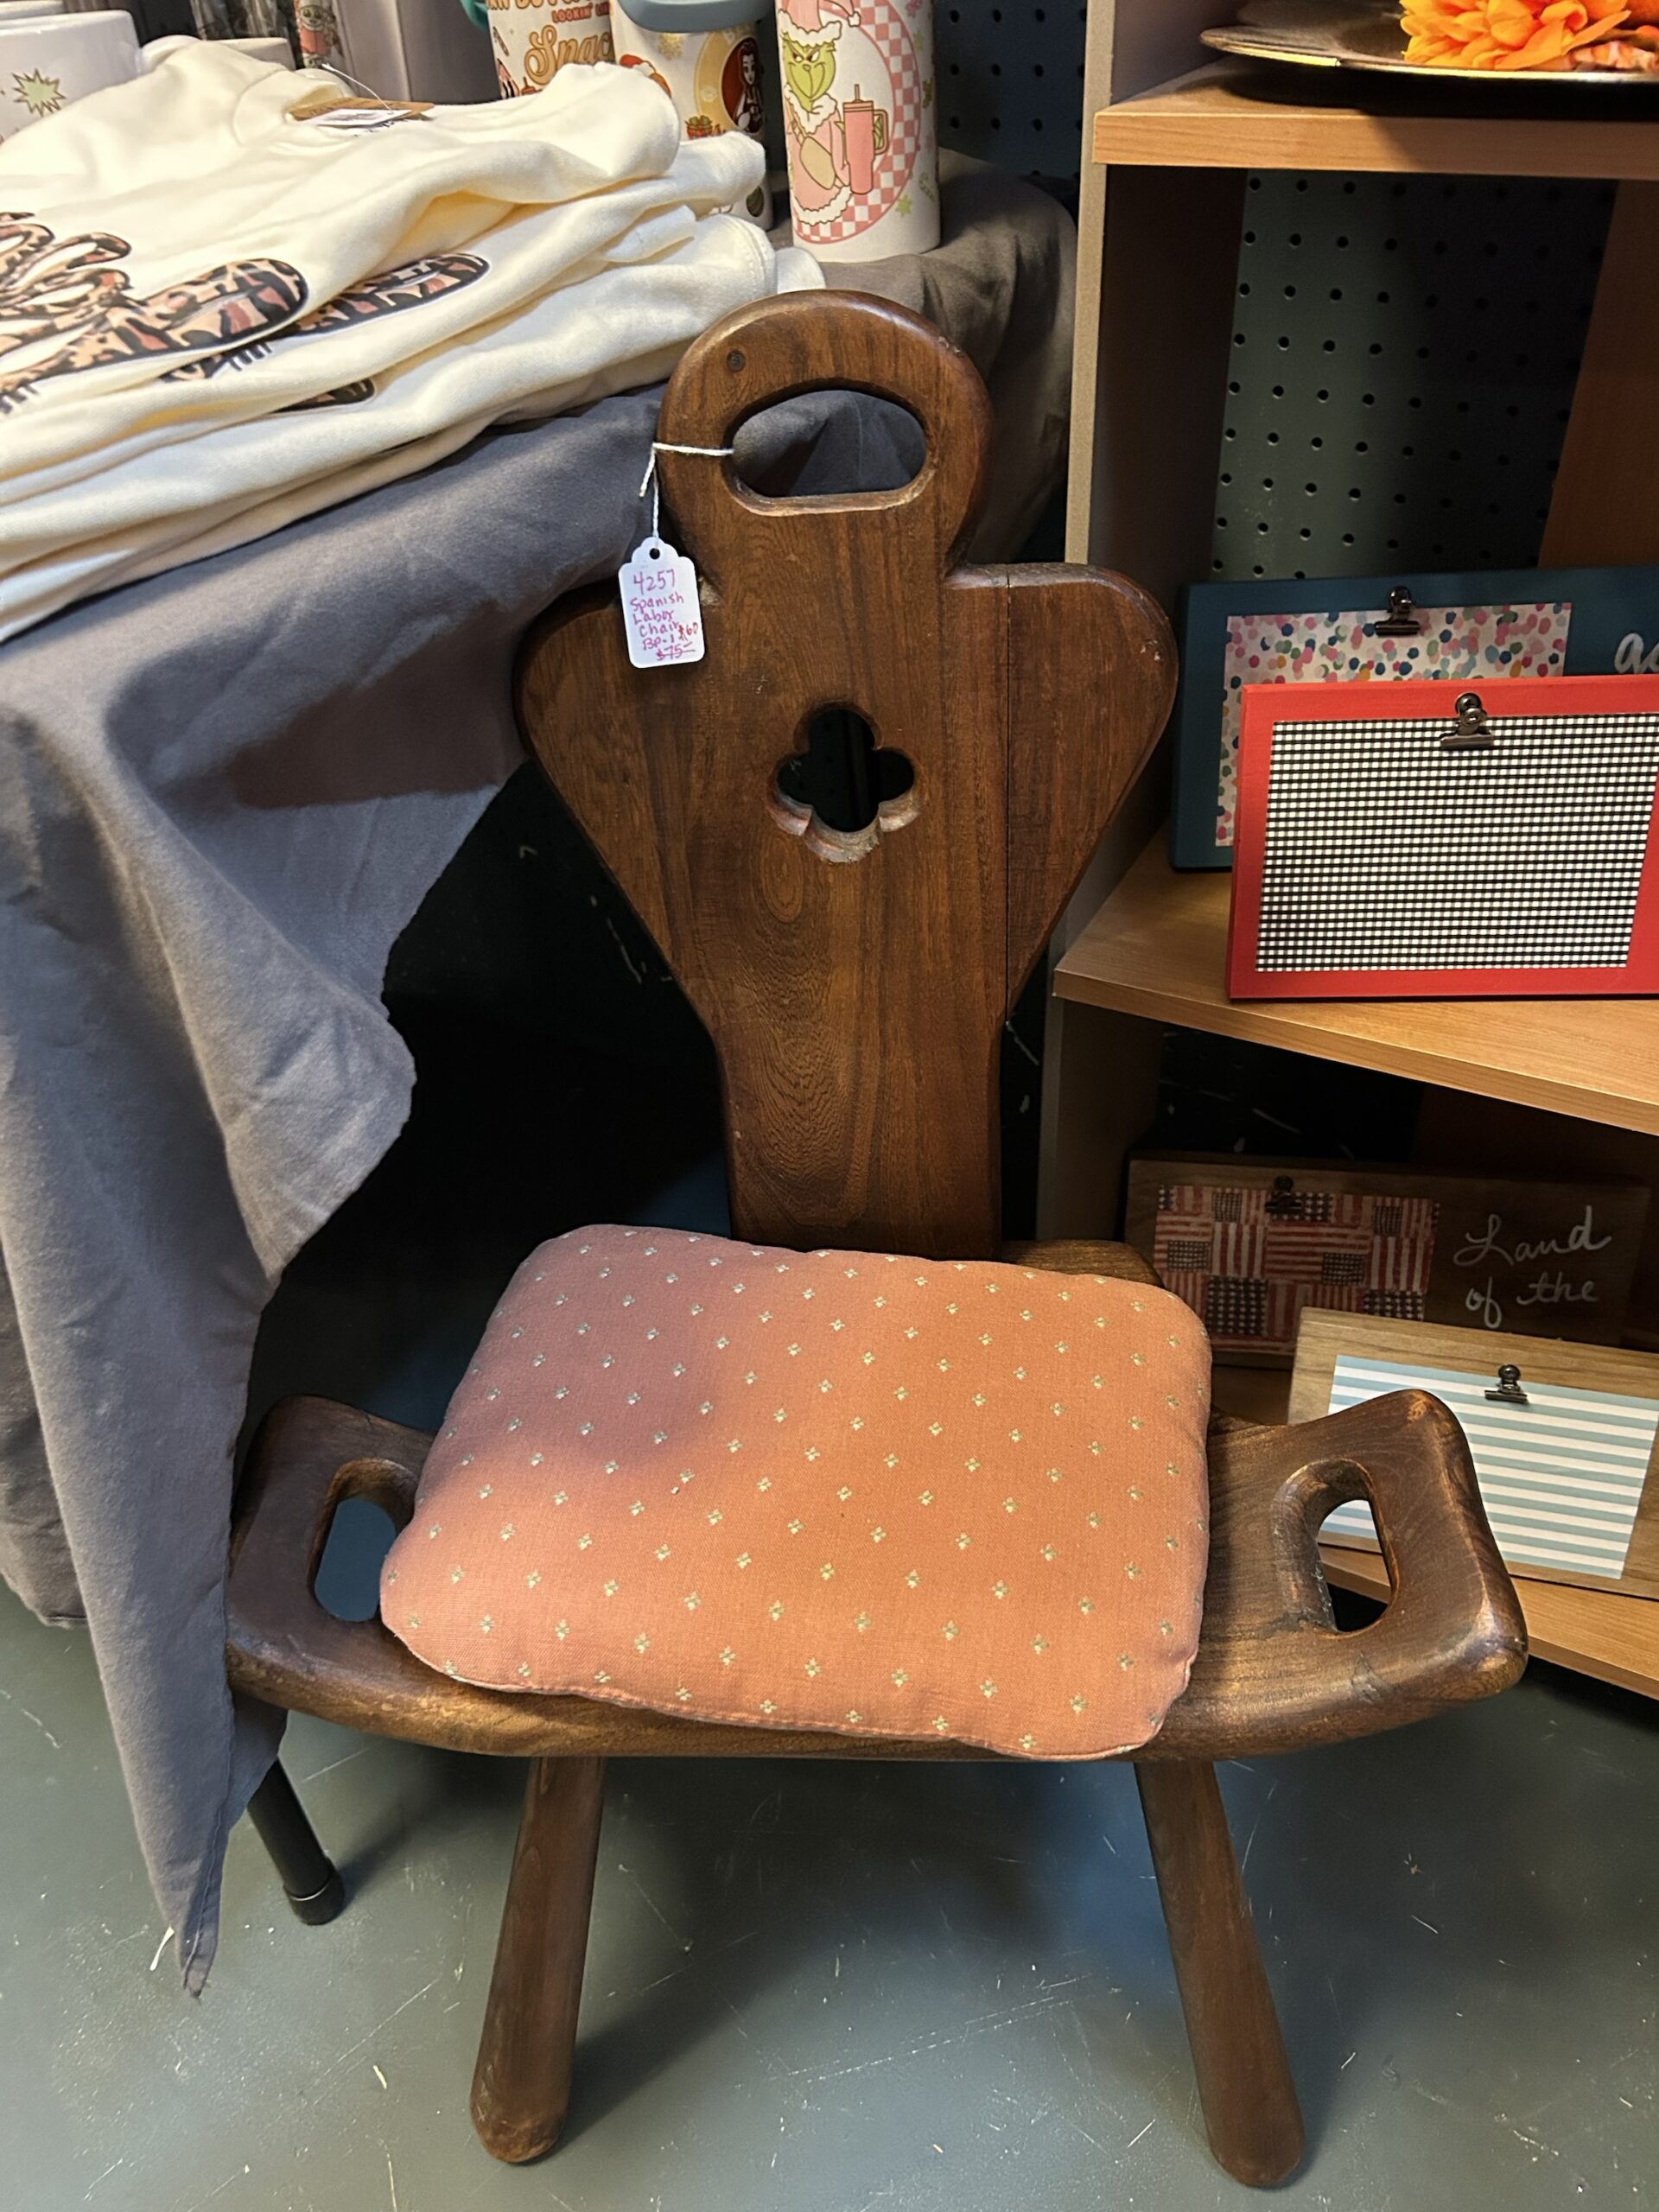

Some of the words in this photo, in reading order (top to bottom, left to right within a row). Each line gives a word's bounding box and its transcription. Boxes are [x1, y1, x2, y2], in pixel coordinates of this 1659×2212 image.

[551, 3, 594, 23] LOOKIN'
[524, 24, 615, 86] Snac
[633, 569, 675, 595] 4257
[630, 591, 684, 614] Spanish
[632, 609, 674, 625] Labor
[639, 621, 679, 637] Chair
[1453, 1205, 1612, 1267] Land
[1465, 1277, 1502, 1329] of
[1516, 1271, 1599, 1306] the
